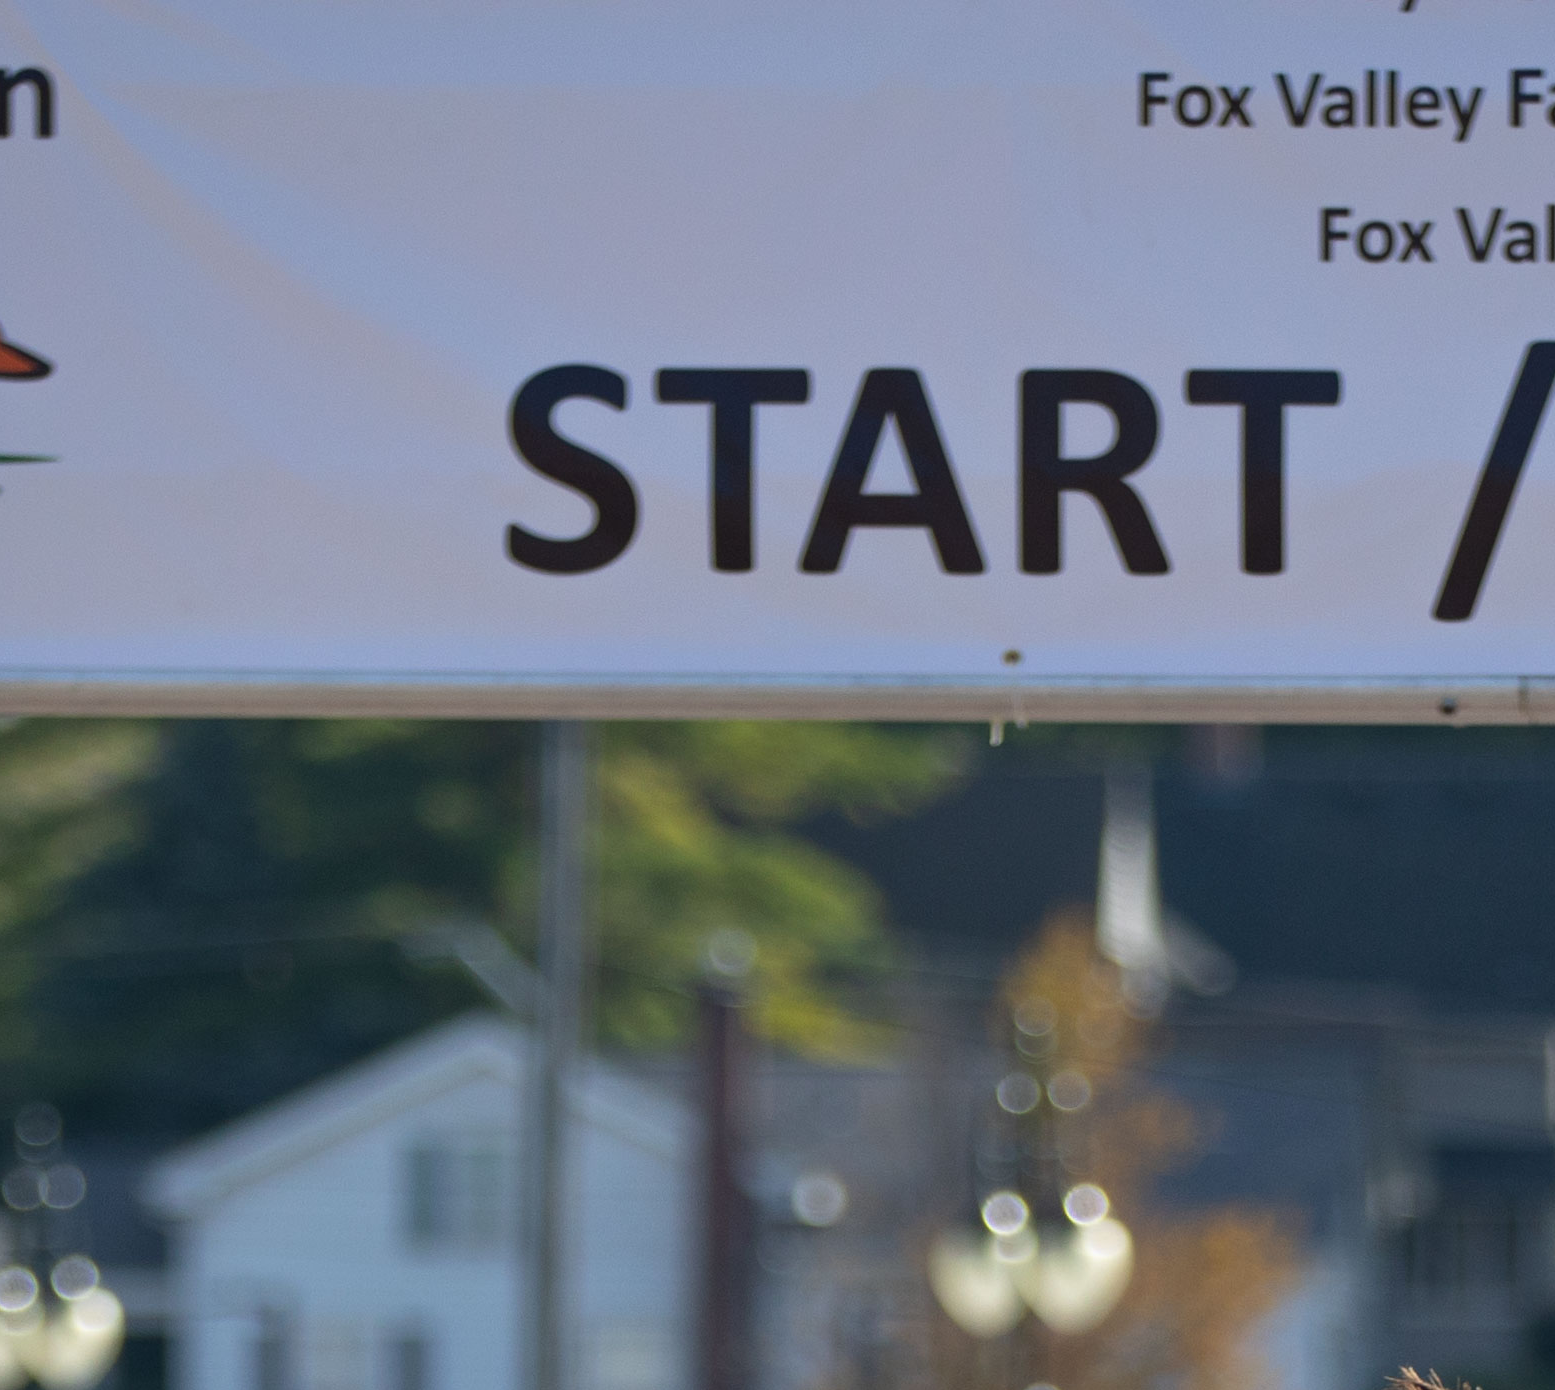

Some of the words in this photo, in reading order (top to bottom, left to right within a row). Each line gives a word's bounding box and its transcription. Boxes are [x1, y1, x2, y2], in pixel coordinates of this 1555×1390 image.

[1137, 71, 1254, 129] Fox
[1277, 70, 1484, 142] Valley
[1318, 206, 1435, 263] Fox
[505, 362, 1344, 577] START
